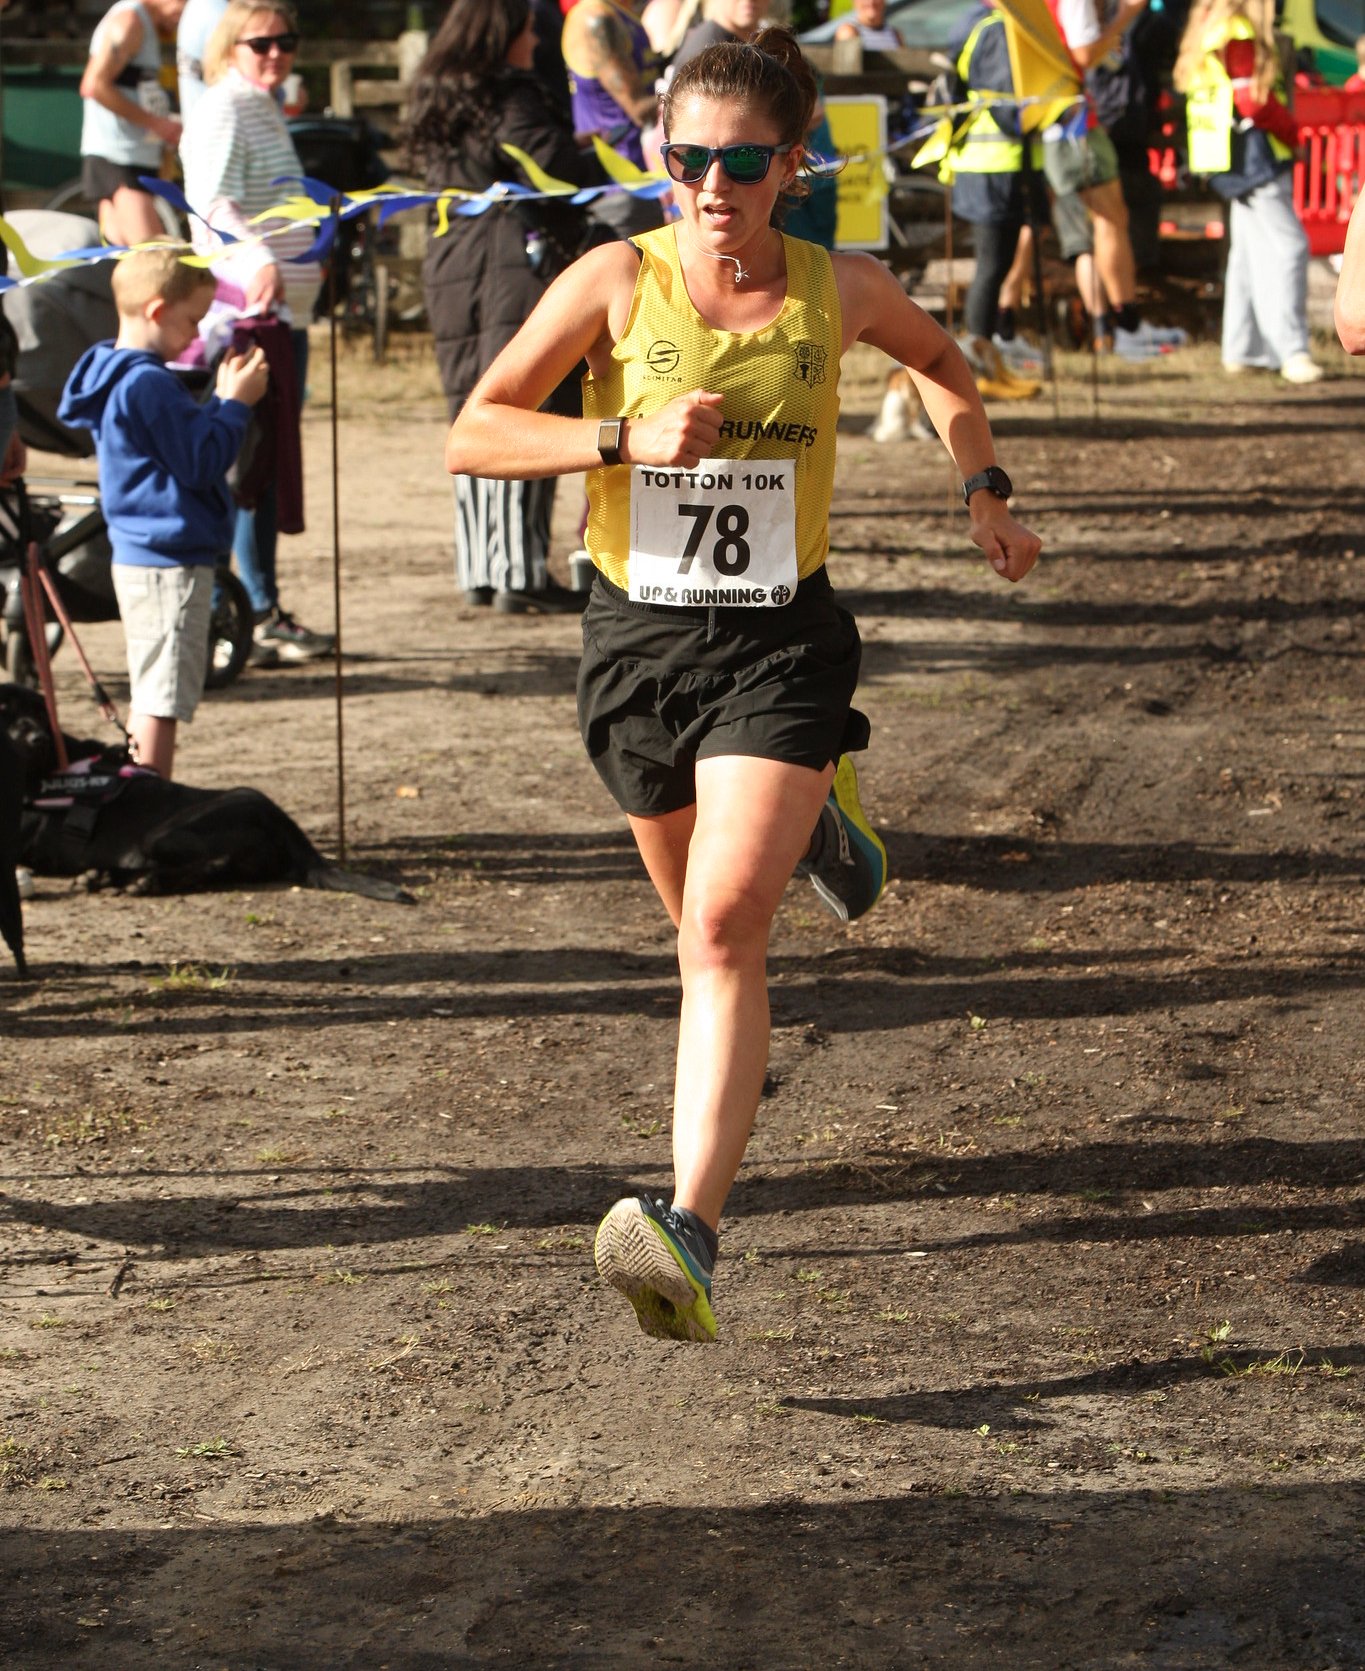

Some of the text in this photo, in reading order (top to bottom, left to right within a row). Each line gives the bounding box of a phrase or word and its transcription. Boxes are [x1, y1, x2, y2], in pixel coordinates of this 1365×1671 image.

[641, 470, 785, 490] TOTTON 10K
[677, 504, 751, 577] 78
[681, 587, 767, 605] RUNNING
